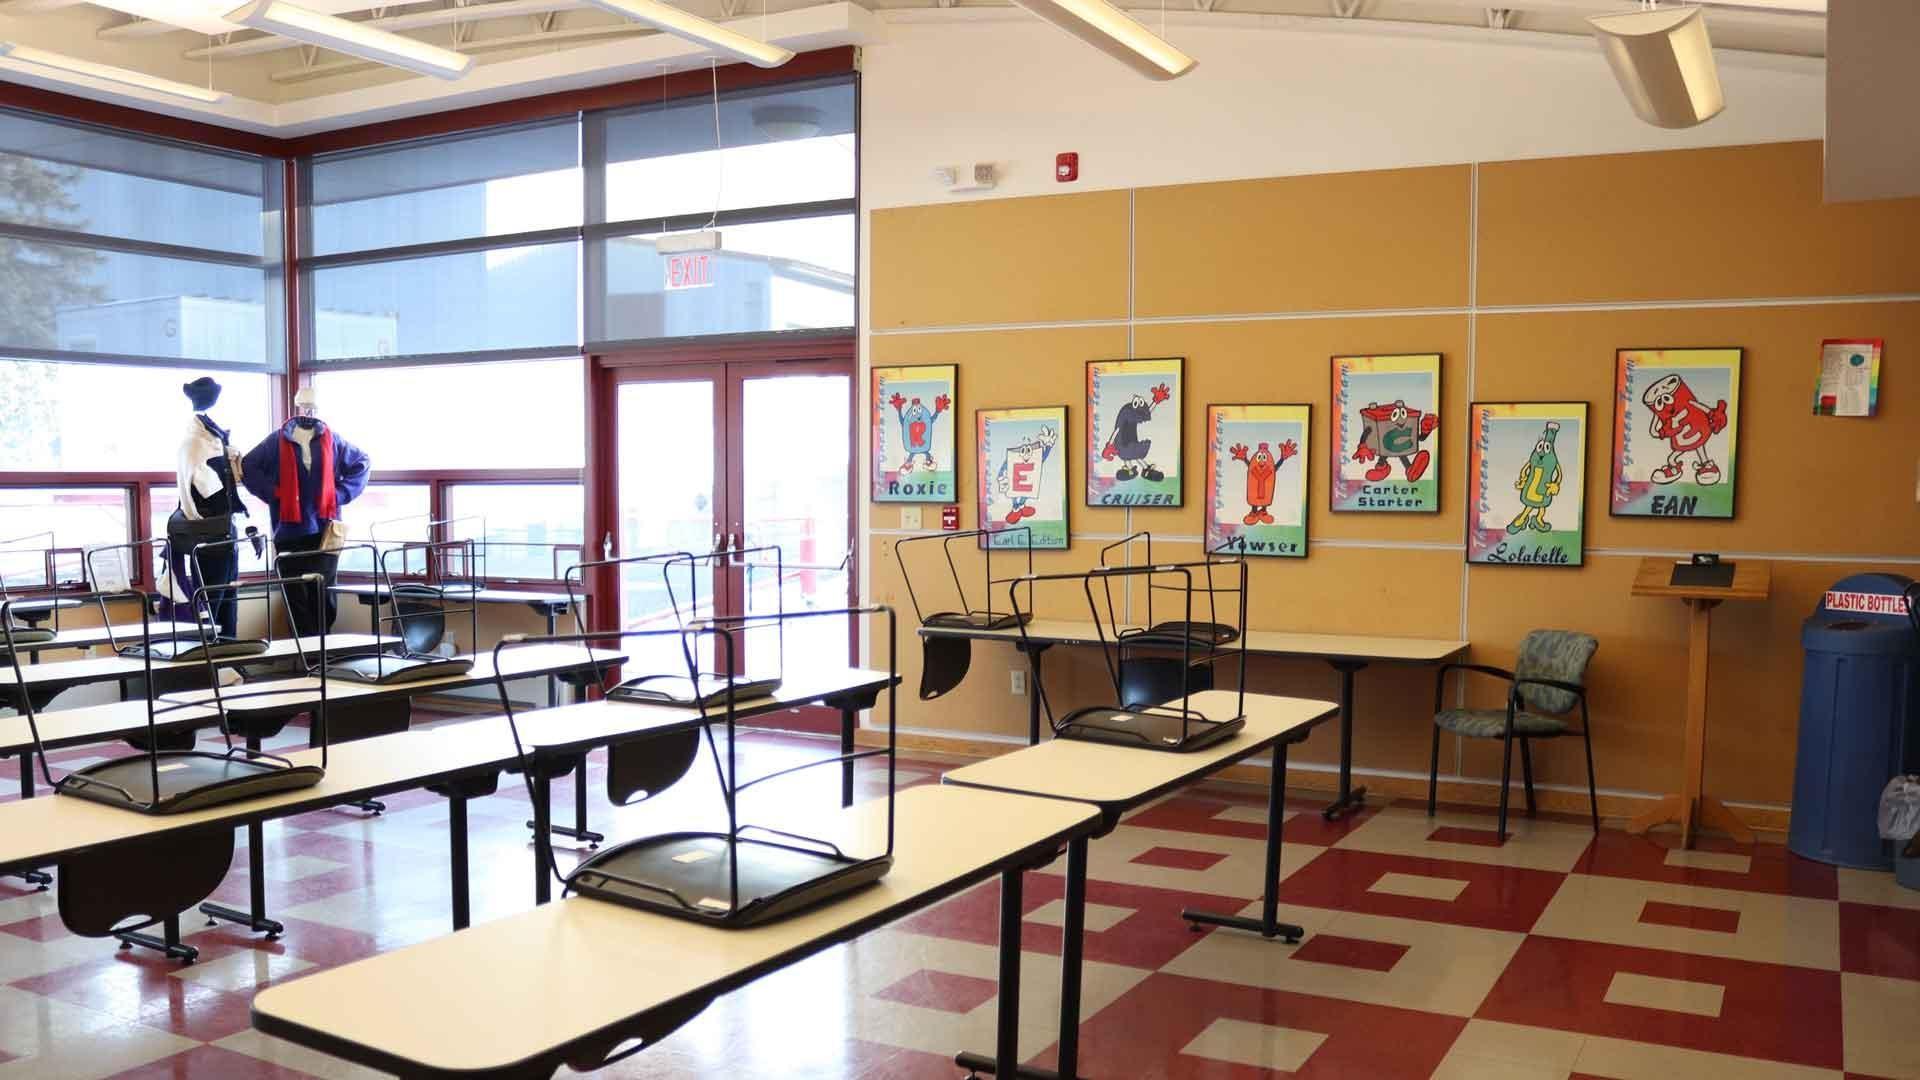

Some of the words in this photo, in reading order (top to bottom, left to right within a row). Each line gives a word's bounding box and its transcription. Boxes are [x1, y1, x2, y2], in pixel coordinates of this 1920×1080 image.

[671, 255, 709, 288] EXIT
[1619, 359, 1635, 402] Team
[909, 421, 927, 448] R
[1382, 427, 1414, 452] C
[1475, 409, 1489, 451] Team
[1624, 411, 1634, 466] Green
[888, 480, 947, 496] Roxie
[1012, 462, 1035, 492] E
[1362, 484, 1419, 495] Carter
[1479, 459, 1490, 513] Green
[1525, 466, 1545, 503] L
[1101, 493, 1175, 505] CRUISER
[1358, 496, 1423, 508] Starter
[1651, 495, 1698, 515] EAN
[1226, 536, 1298, 553] Yowser
[1487, 542, 1569, 564] Lolabelle
[1826, 592, 1865, 609] PLASTIC
